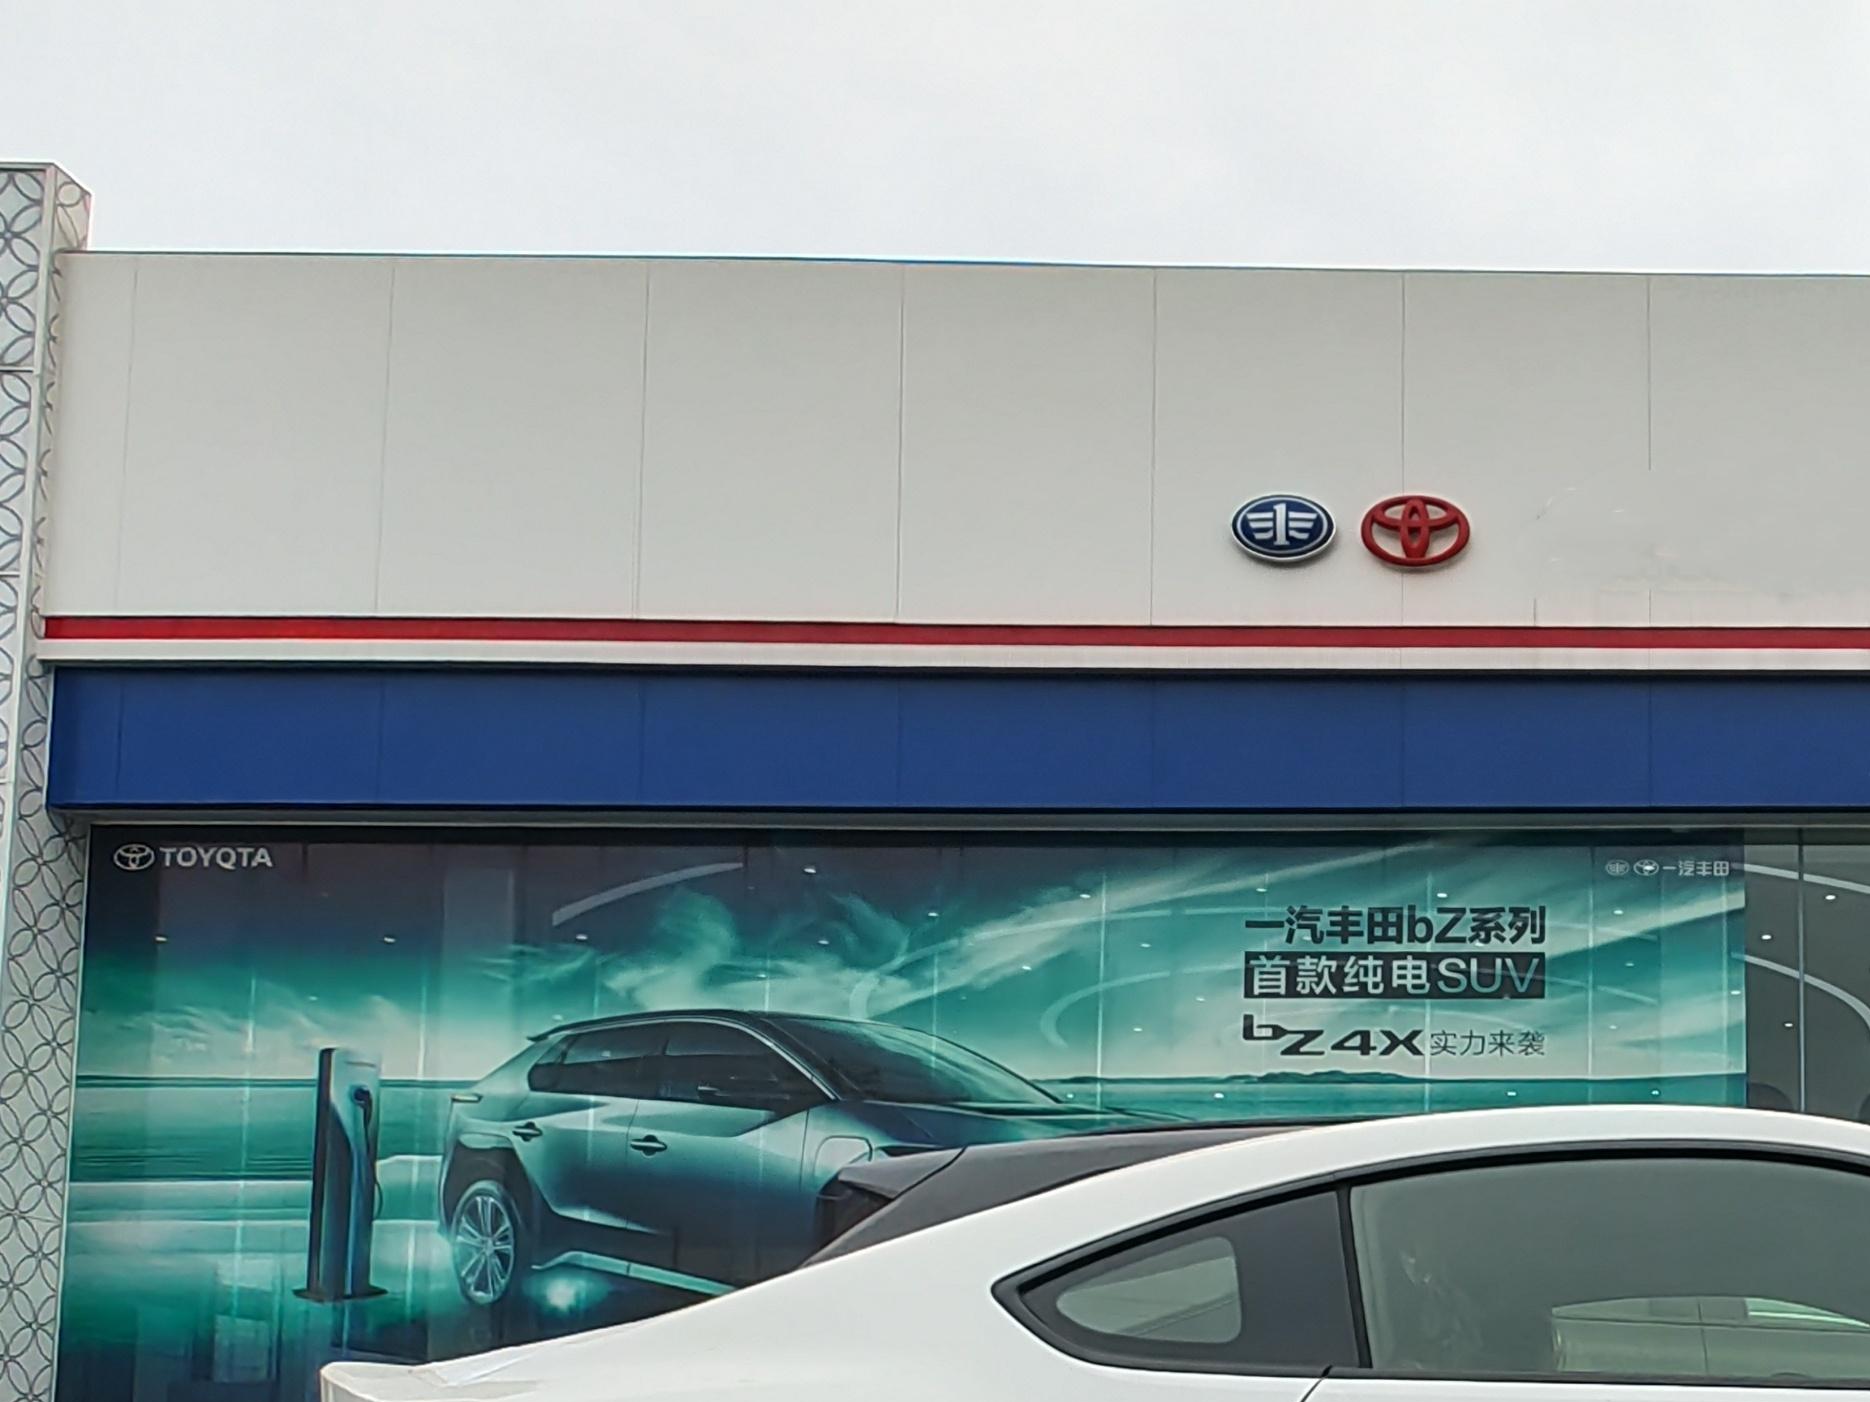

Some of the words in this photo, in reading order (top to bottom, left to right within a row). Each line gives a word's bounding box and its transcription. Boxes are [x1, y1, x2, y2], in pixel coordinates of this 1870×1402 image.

[1662, 860, 1730, 876] 一汽丰田
[1244, 905, 1547, 945] 一汽丰田bZ系列
[1250, 955, 1541, 996] 首款纯电SUV
[1429, 1029, 1546, 1057] 实力来袭
